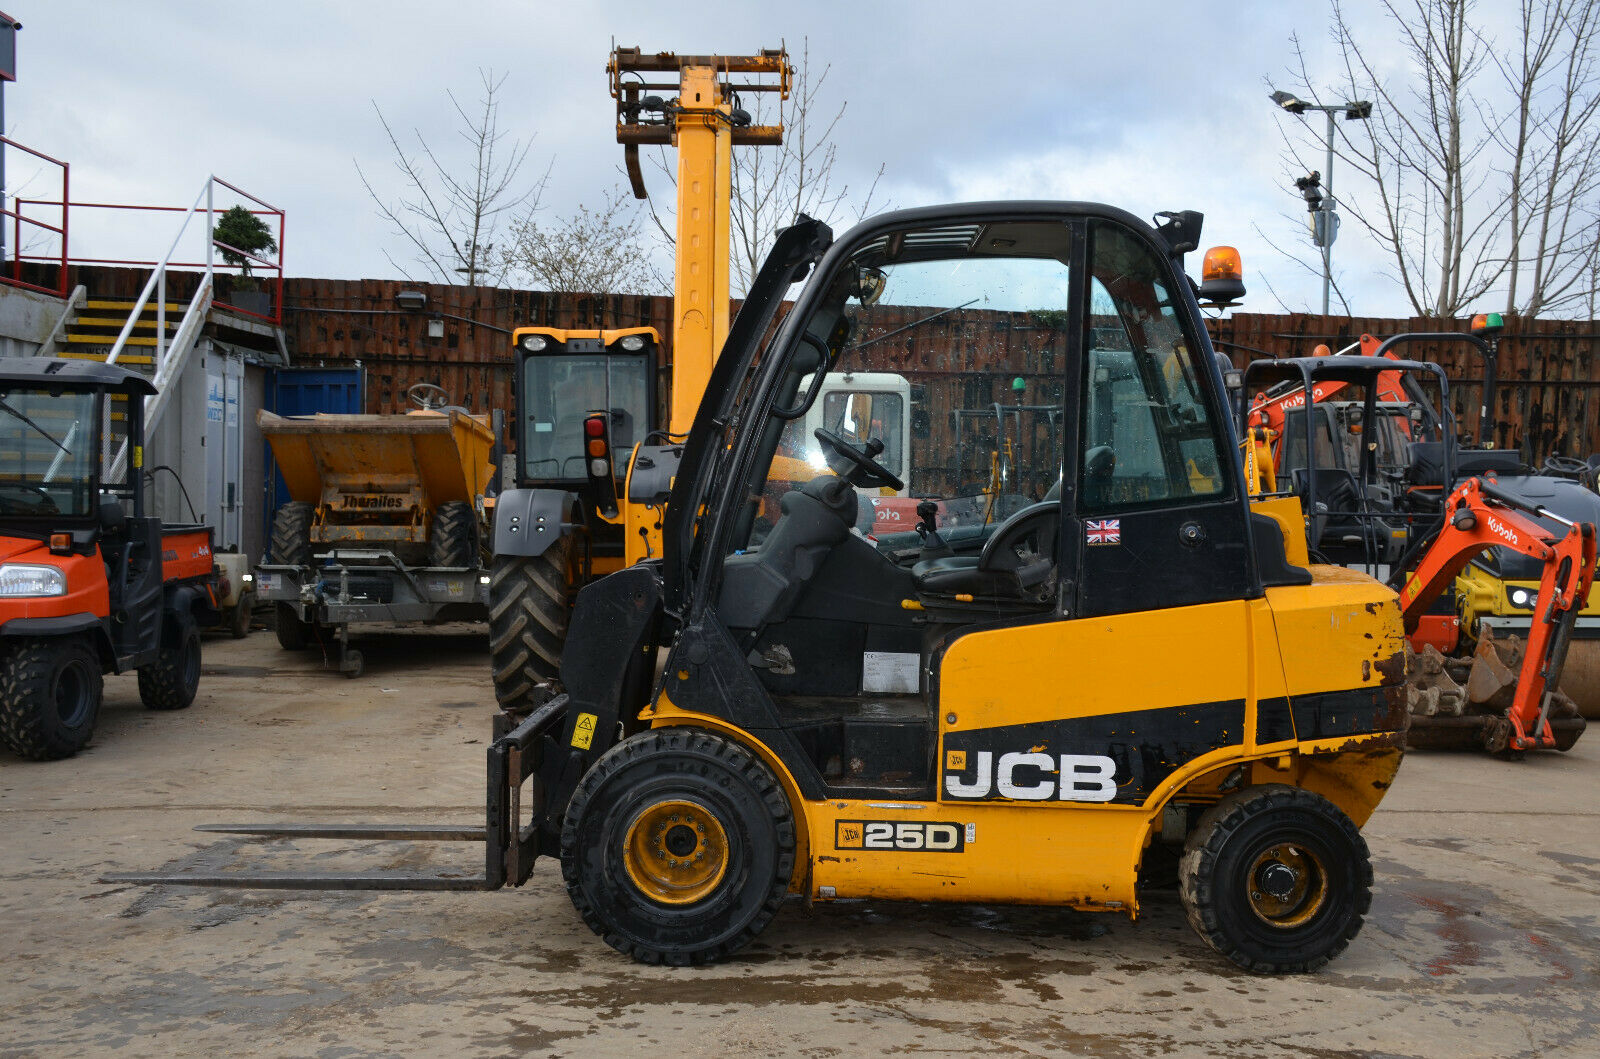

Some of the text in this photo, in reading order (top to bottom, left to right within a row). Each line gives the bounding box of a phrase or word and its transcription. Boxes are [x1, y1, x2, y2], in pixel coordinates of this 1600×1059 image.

[1487, 516, 1519, 546] Kubota
[946, 751, 1118, 802] JCB
[844, 828, 860, 841] JCB
[865, 823, 958, 850] 25D
